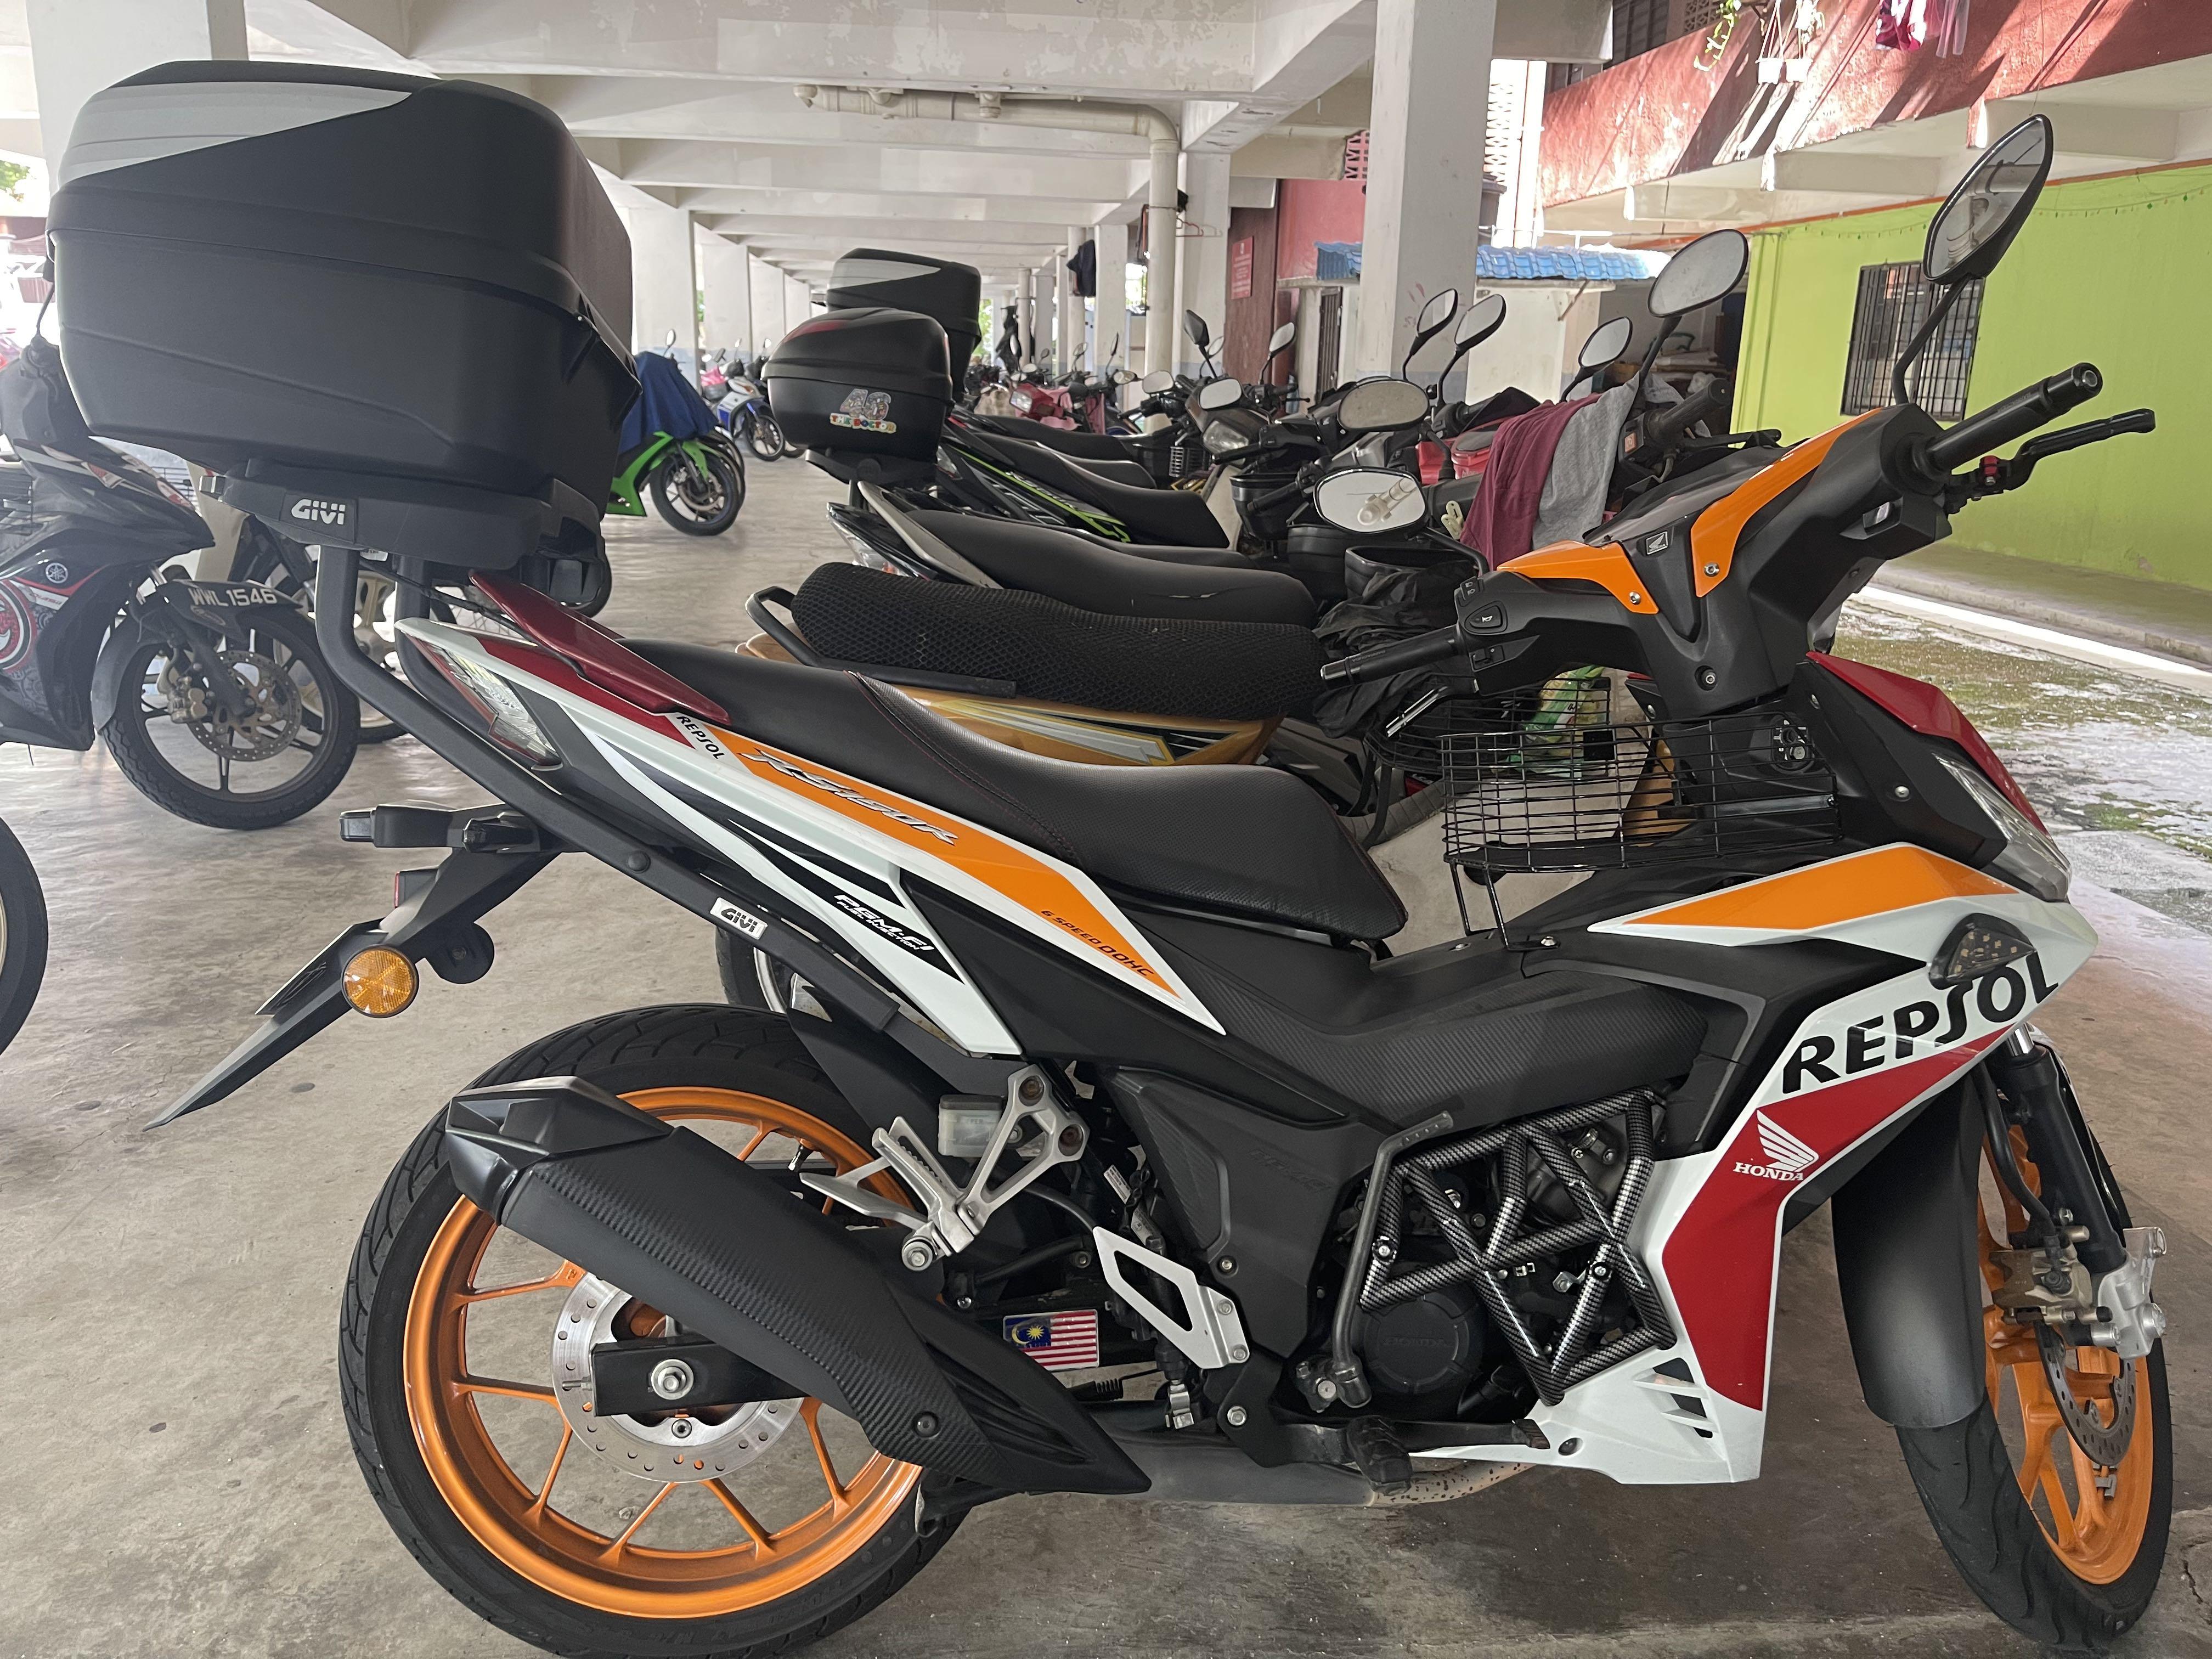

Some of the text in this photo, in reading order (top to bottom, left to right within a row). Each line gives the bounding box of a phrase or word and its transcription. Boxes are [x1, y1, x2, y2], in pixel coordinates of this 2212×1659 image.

[840, 388, 891, 420] 46
[831, 414, 895, 433] THE DOCTOR
[291, 499, 346, 525] GIVI
[188, 588, 277, 607] WWL 1546
[676, 716, 725, 759] REPSOL
[721, 908, 758, 933] GIVI
[837, 901, 919, 950] FUEL INJECTION
[1052, 917, 1102, 944] SPEED
[1098, 945, 1154, 976] DOHC
[1782, 952, 2058, 1094] REPSOL
[1733, 1161, 1804, 1182] HONDA
